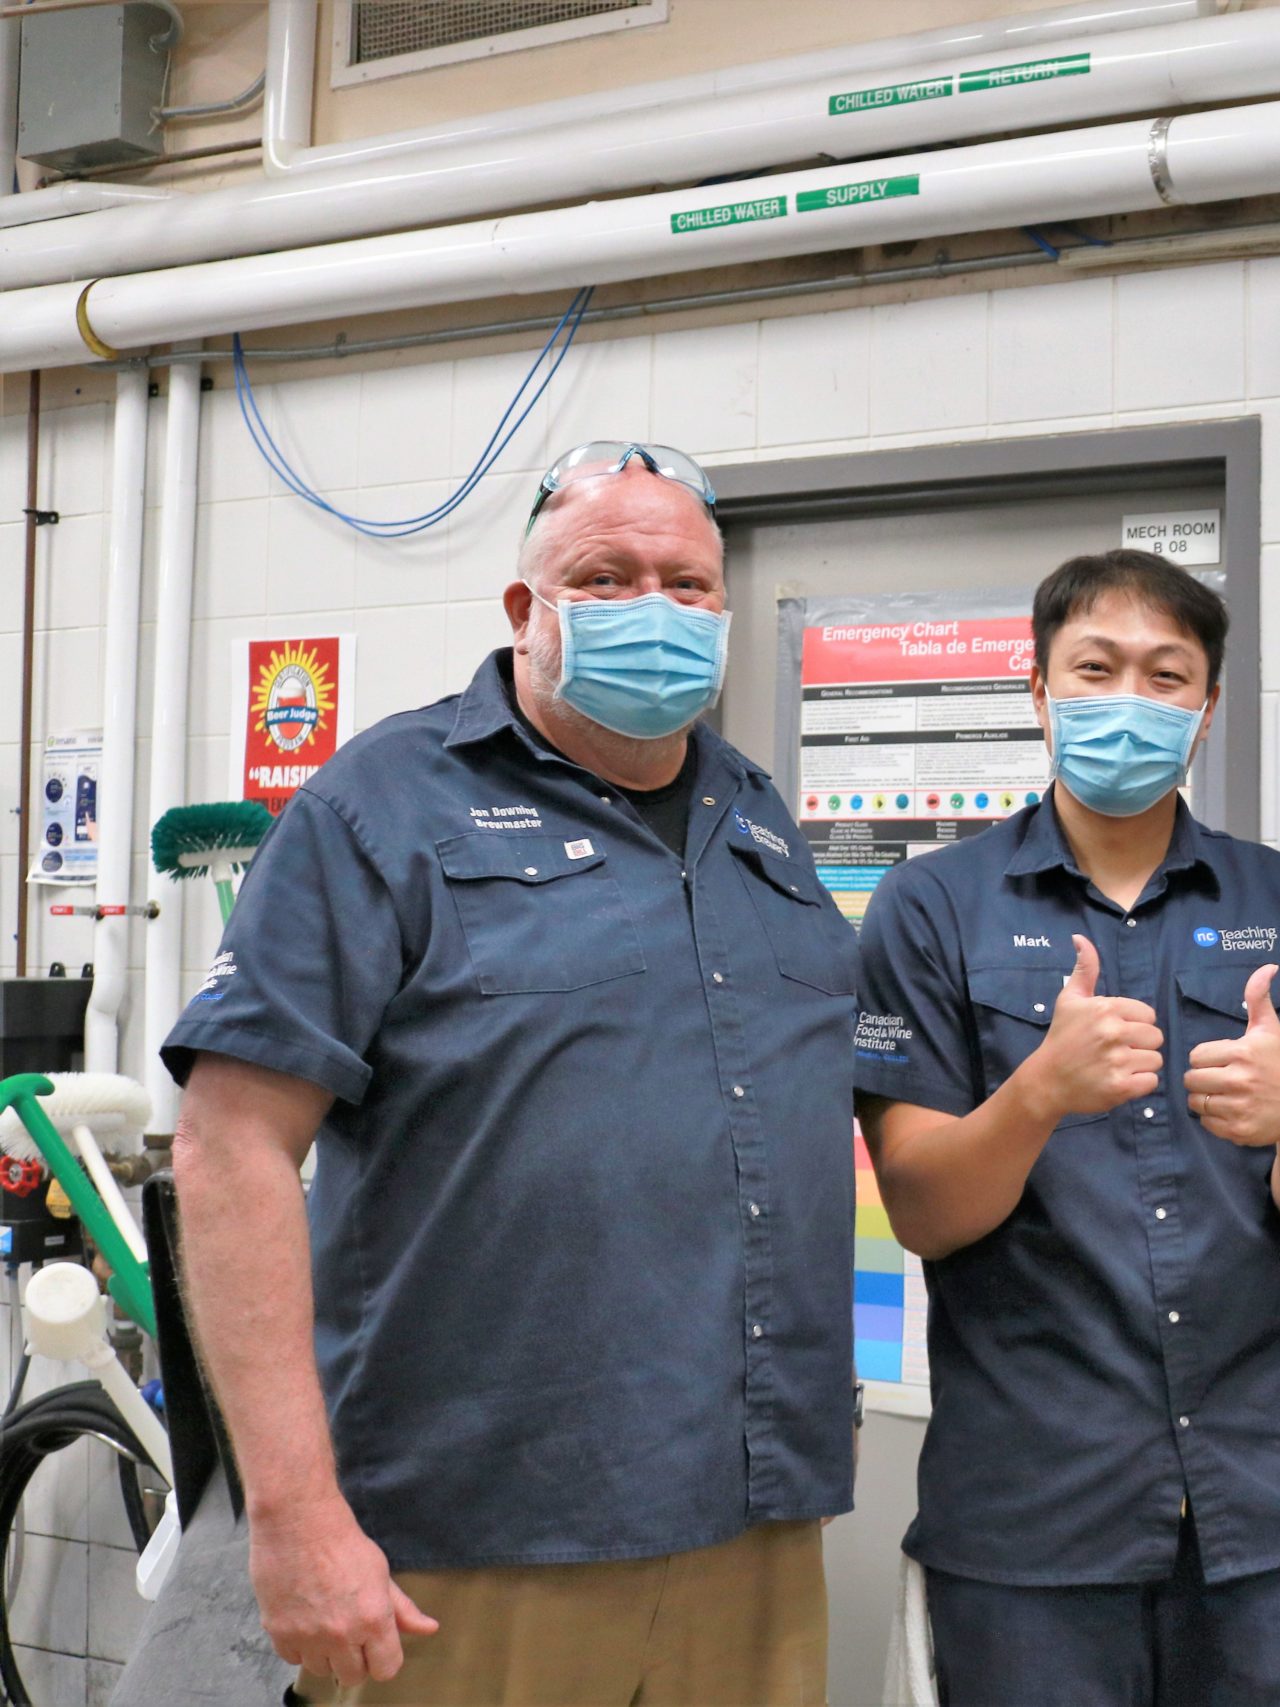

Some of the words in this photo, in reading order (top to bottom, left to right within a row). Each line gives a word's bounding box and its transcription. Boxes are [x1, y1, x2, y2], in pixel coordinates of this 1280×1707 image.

[988, 60, 1061, 86] RETURN
[835, 87, 893, 112] CHILLED
[896, 80, 946, 100] WATER
[826, 181, 889, 206] SUPPLY
[676, 207, 731, 230] CHILLED
[733, 199, 780, 220] WATER
[1126, 525, 1167, 540] MECH
[1172, 521, 1216, 537] ROOM
[1153, 541, 1163, 554] B
[1168, 539, 1188, 553] 08
[822, 624, 909, 643] Emergency
[913, 621, 959, 637] Chart
[900, 640, 942, 656] Tabla
[946, 640, 967, 655] de
[1008, 656, 1036, 671] Ca
[267, 710, 289, 722] Beer
[289, 708, 317, 722] Judge
[469, 807, 490, 817] Jon
[491, 805, 540, 818] Downing
[474, 818, 543, 829] Brewmaster
[1013, 934, 1050, 948] Mark
[1197, 932, 1215, 942] nc
[1218, 926, 1278, 939] Teaching
[1222, 938, 1275, 952] Brewery
[859, 1011, 904, 1027] Canadian
[853, 1036, 897, 1051] Institute
